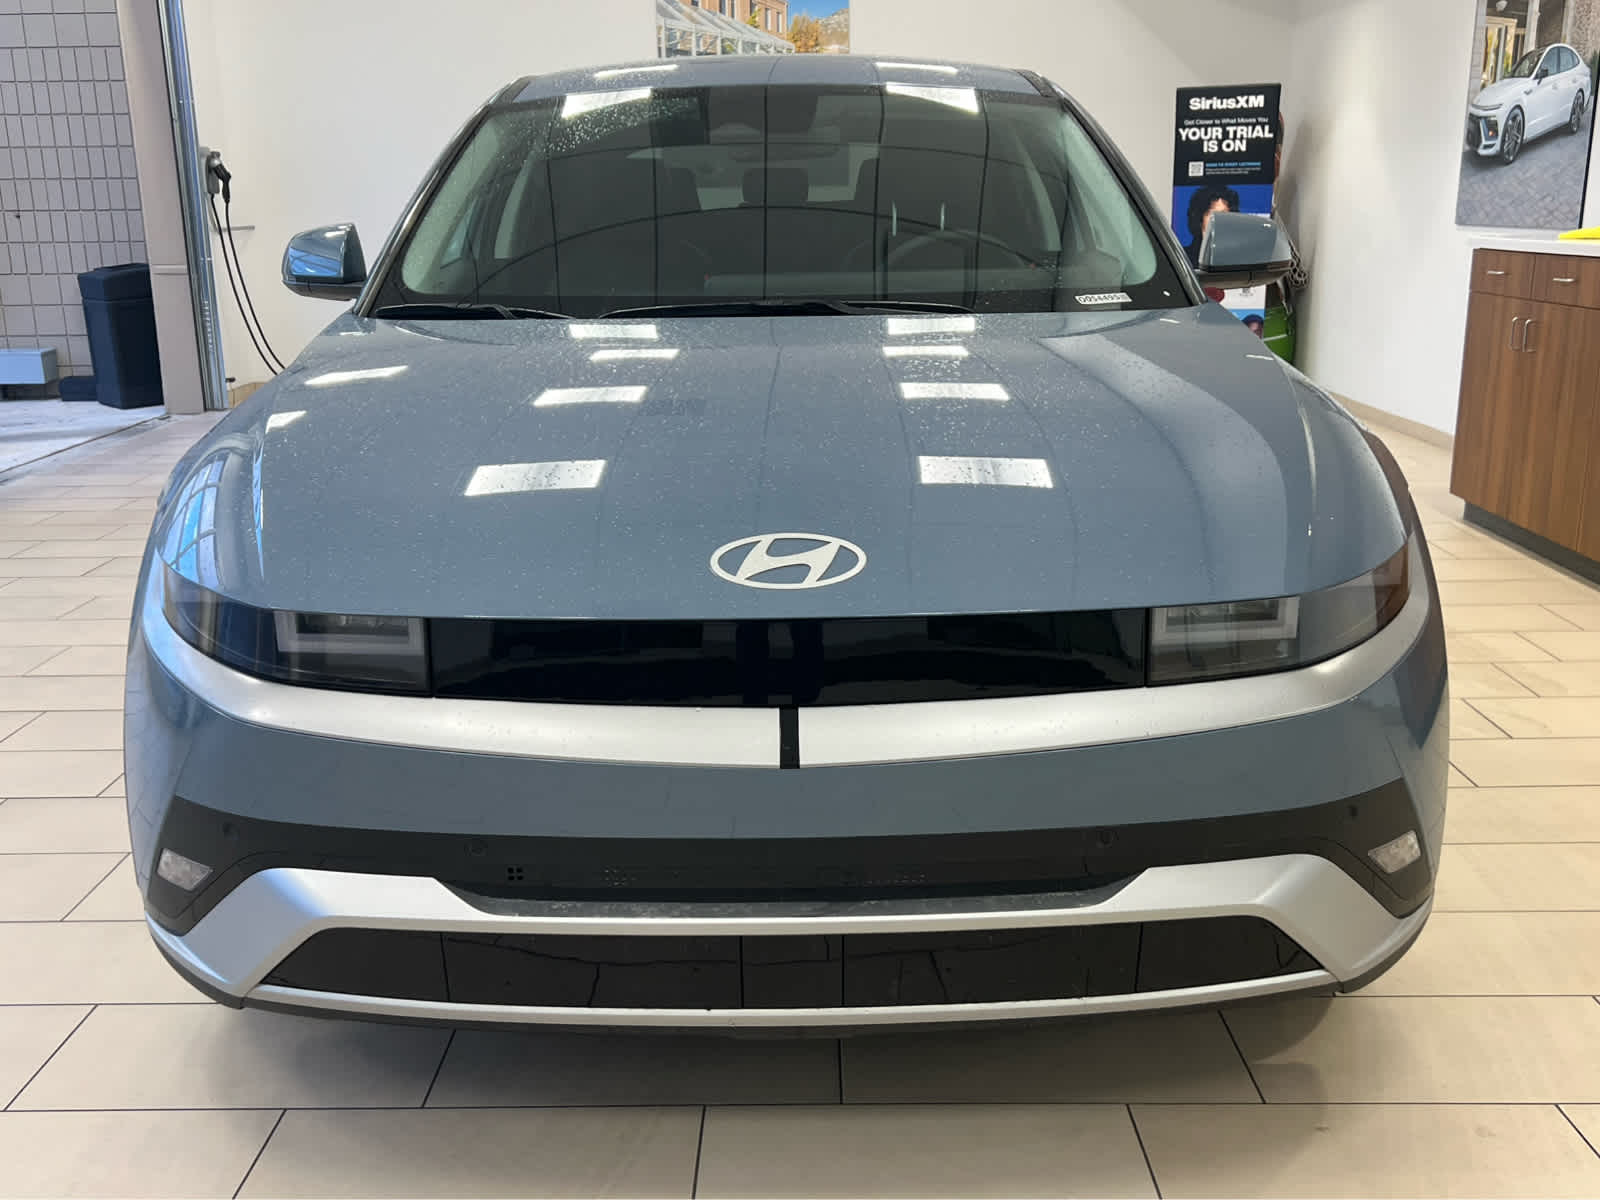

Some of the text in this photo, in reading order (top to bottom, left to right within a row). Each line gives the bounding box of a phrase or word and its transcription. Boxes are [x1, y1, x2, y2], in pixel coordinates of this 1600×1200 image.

[1189, 95, 1264, 110] SiriusXM
[1178, 125, 1273, 140] YOUR TRIAL
[1203, 139, 1247, 153] IS ON
